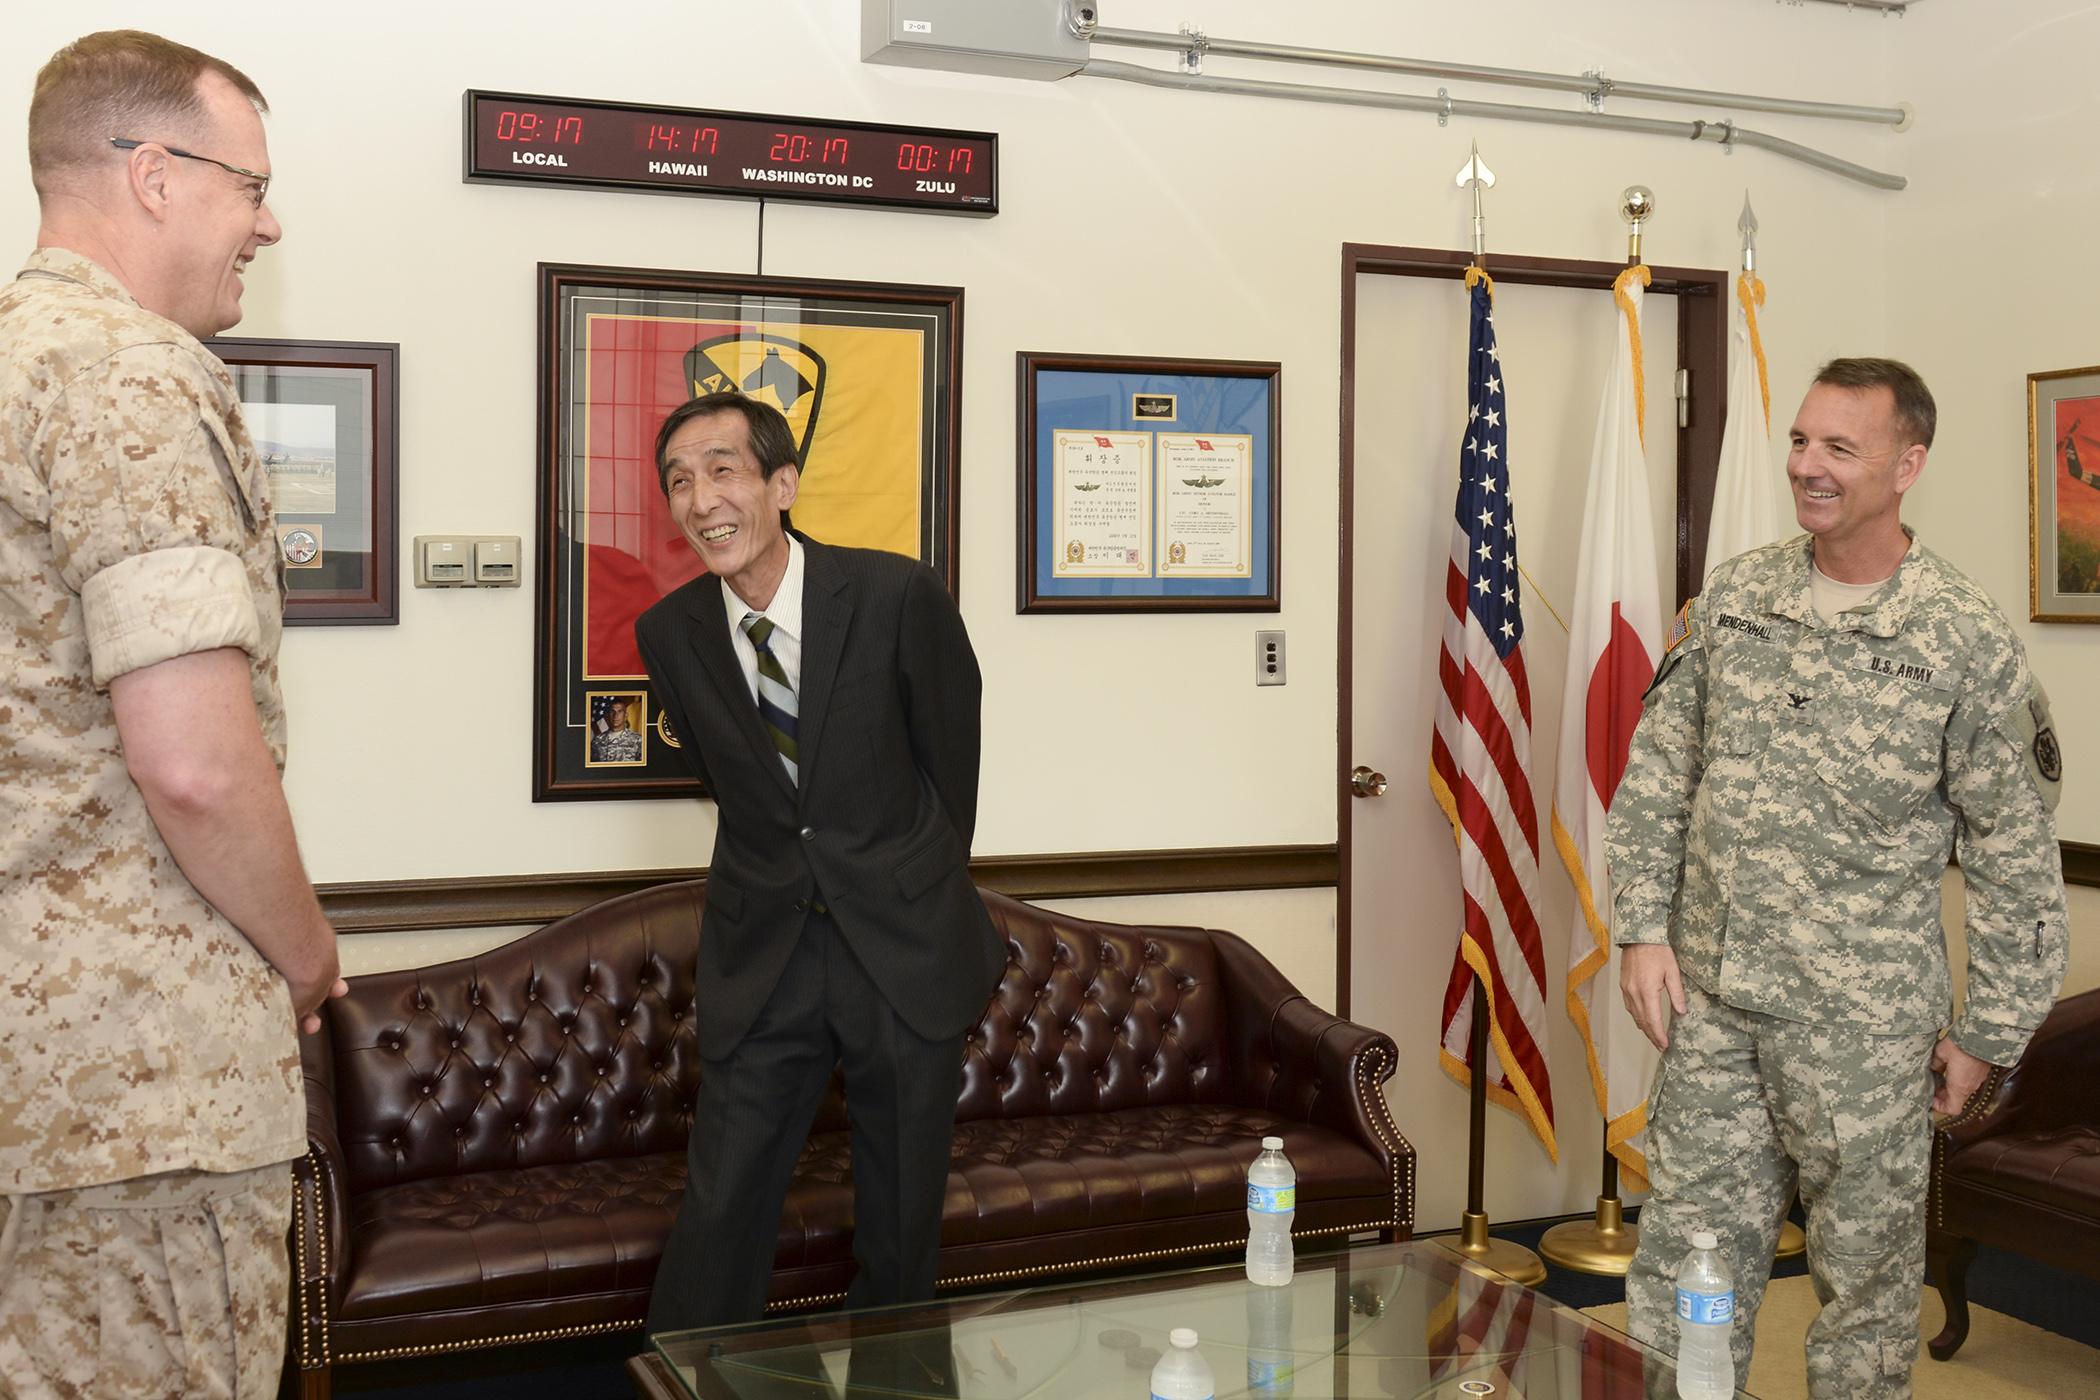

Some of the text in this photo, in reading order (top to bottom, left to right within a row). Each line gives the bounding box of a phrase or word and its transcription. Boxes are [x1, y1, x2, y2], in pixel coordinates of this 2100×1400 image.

[497, 111, 582, 144] 09:17
[648, 124, 718, 154] 14:17
[512, 151, 568, 167] LOCAL
[770, 133, 848, 164] 20:17
[898, 143, 972, 174] 00:17
[648, 161, 708, 177] HAWAII
[742, 168, 874, 188] WASHINGTON DC
[915, 180, 956, 194] ZULU
[1718, 613, 1771, 640] MENDENHALL
[1870, 656, 1934, 683] U.S. ARMY
